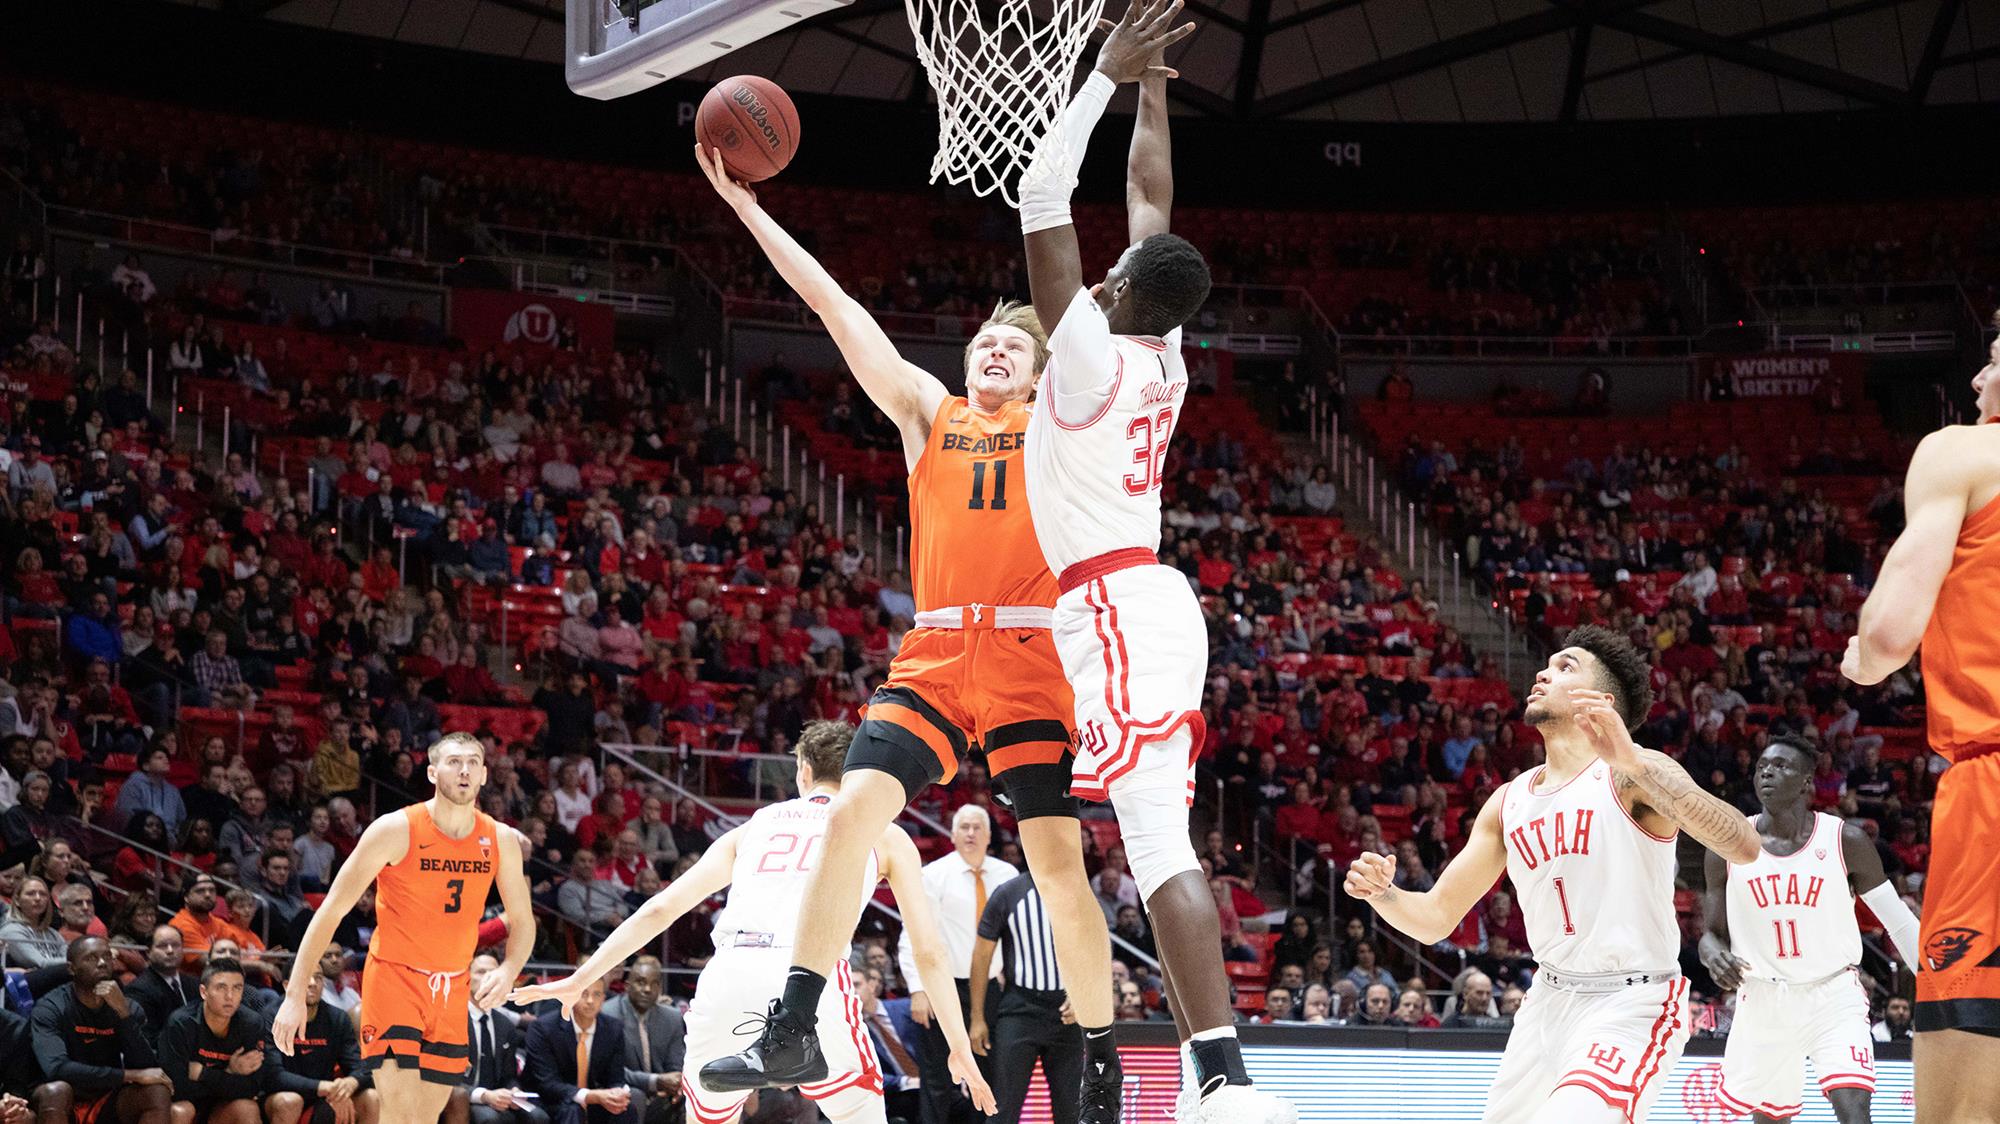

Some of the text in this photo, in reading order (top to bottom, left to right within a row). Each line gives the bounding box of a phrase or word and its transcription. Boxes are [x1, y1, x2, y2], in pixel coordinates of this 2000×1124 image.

[732, 85, 781, 150] Wilson
[1123, 406, 1174, 496] 32
[968, 460, 1007, 510] 11
[1510, 808, 1595, 871] UTAH
[420, 858, 492, 874] BEAVERS
[1747, 873, 1825, 909] UTAH
[444, 879, 465, 914] 3
[1552, 876, 1576, 936] 1
[1771, 919, 1803, 960] 11
